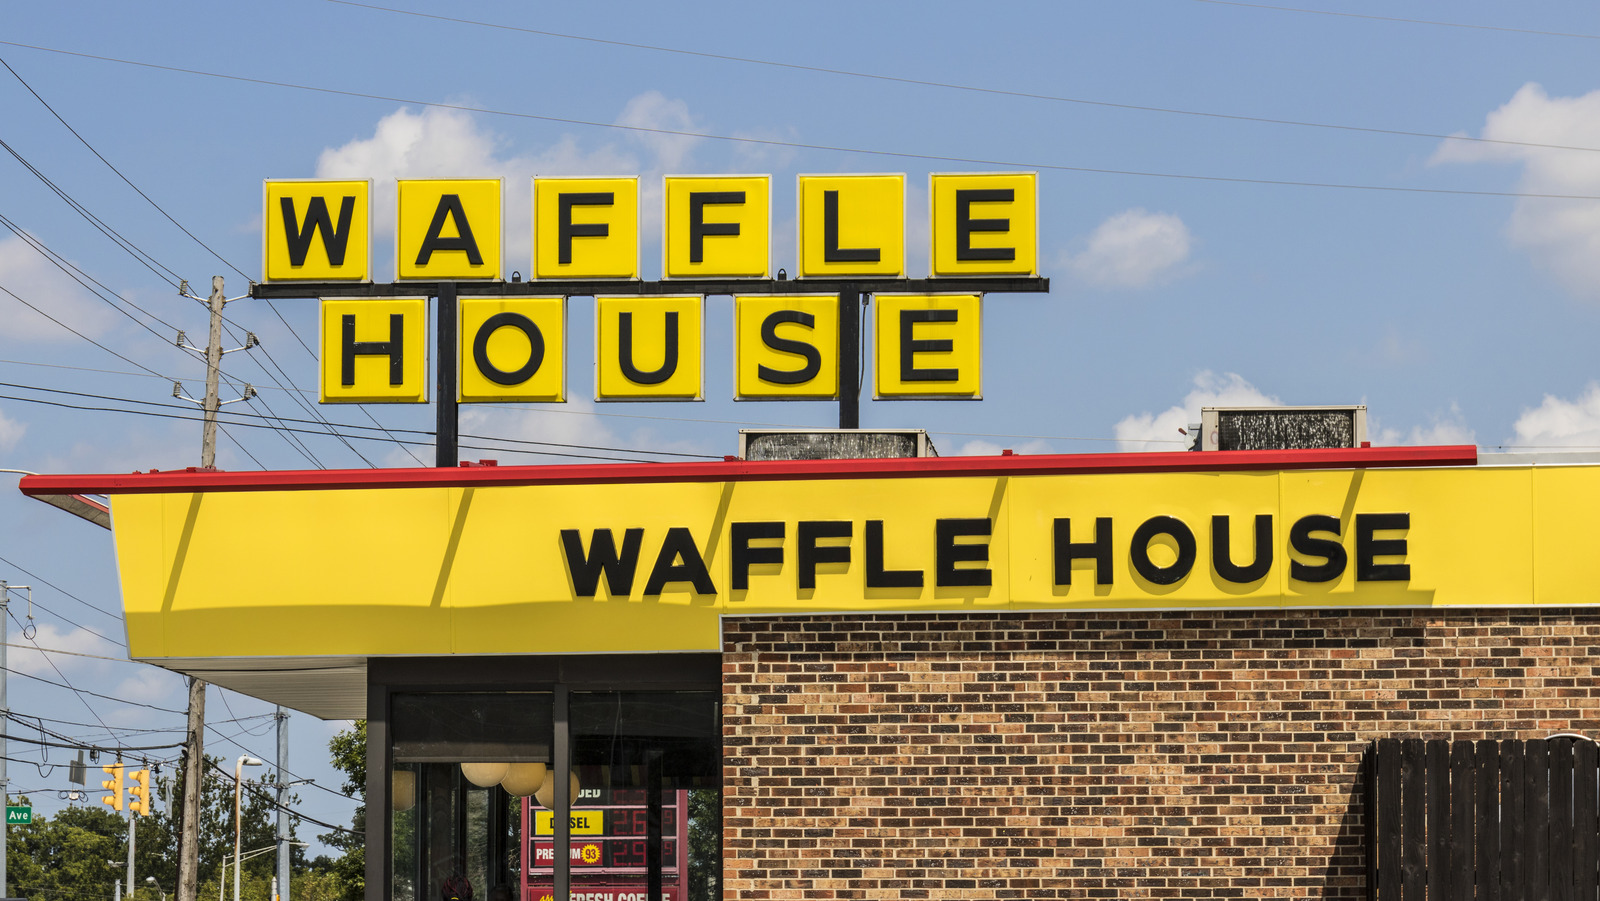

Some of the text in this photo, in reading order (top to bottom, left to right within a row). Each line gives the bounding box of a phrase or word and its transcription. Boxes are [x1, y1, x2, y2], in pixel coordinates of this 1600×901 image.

[280, 188, 1016, 267] WAFFLE
[341, 309, 959, 386] HOUSE
[560, 512, 1411, 597] WAFFLE HOUSE
[9, 811, 29, 820] Ave
[549, 817, 590, 829] DSEL
[585, 848, 597, 860] 93
